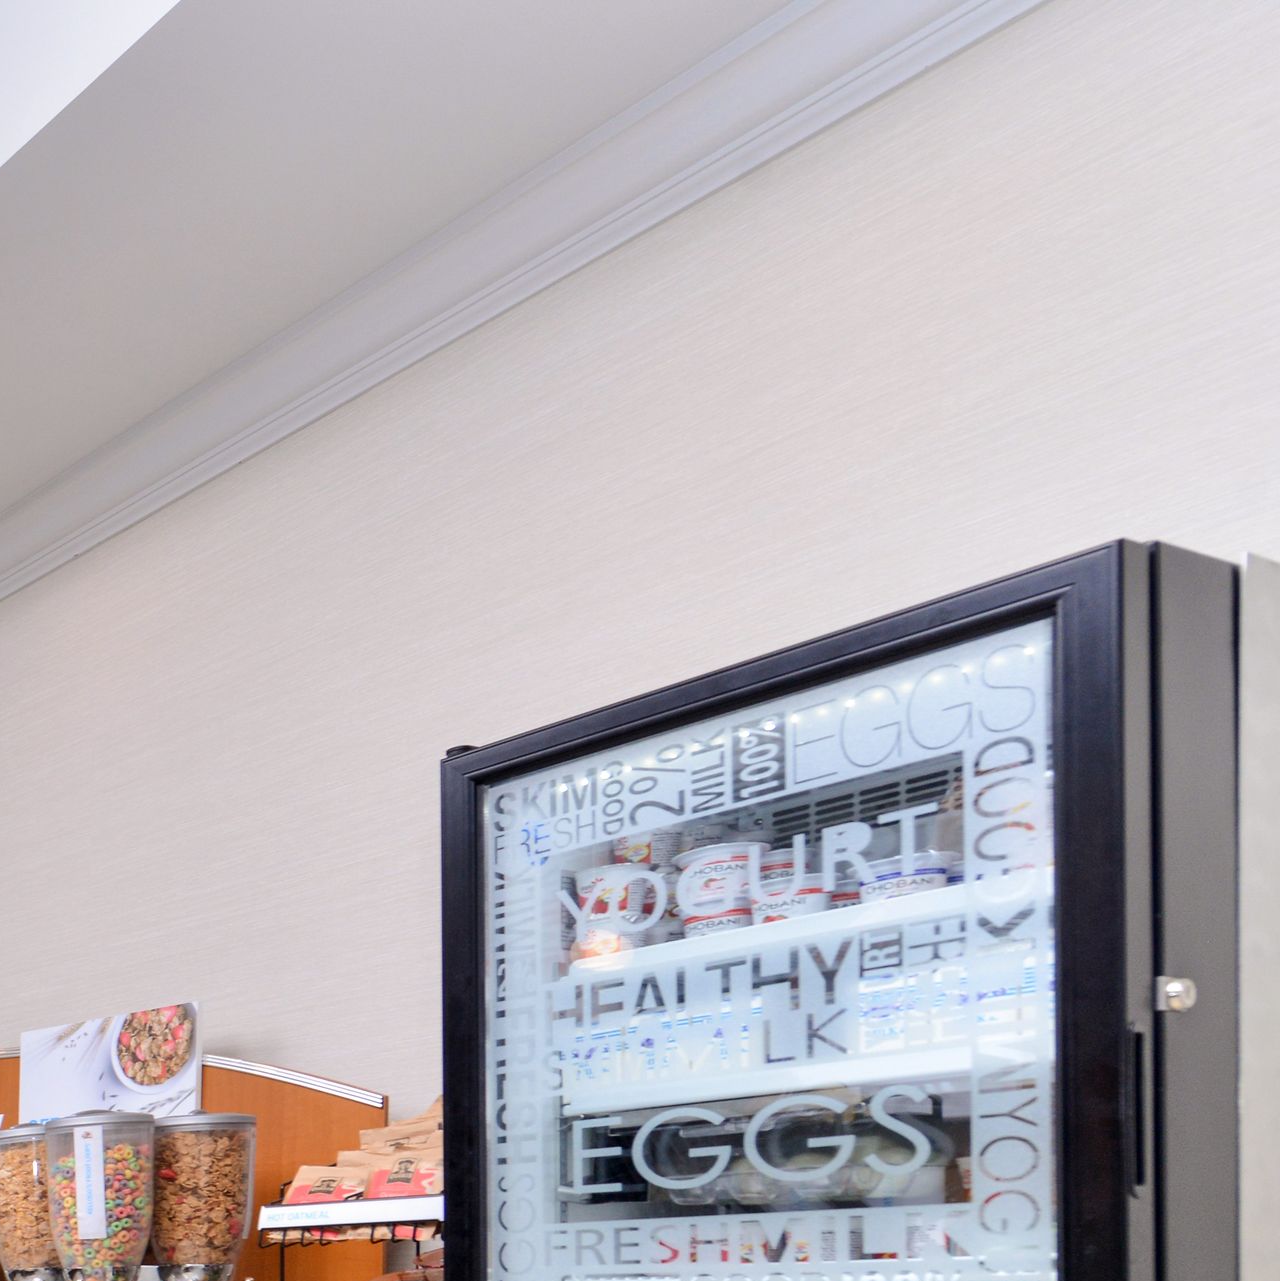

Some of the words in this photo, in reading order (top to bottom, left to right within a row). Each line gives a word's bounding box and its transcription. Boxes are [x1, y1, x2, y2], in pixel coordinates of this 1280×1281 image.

[793, 643, 1037, 784] EGGS
[494, 767, 598, 831] SKIM
[691, 729, 725, 814] MILK
[555, 801, 940, 944] YOGURT
[545, 937, 853, 1046] HEALTHY
[570, 1084, 933, 1195] EGGS
